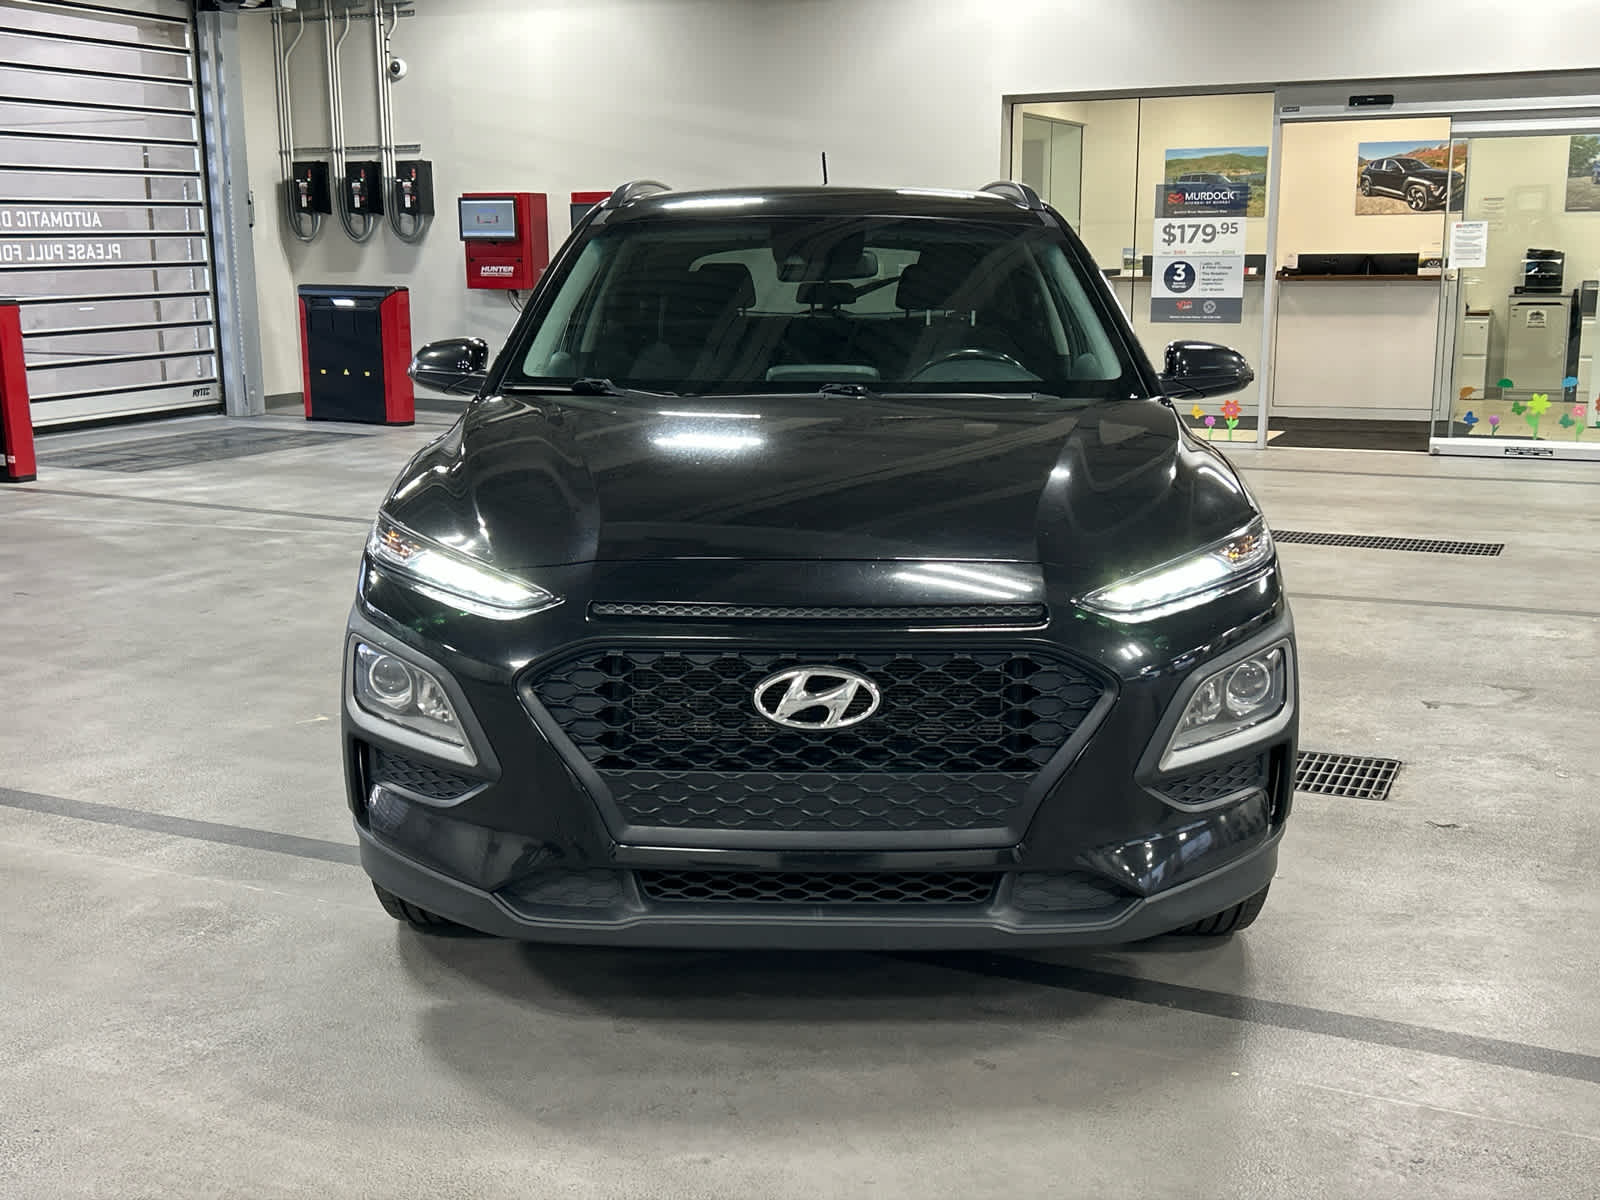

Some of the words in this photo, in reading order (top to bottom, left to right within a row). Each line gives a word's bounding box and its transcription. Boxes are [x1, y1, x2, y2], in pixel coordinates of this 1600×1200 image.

[1185, 191, 1234, 201] MURDOCK
[1162, 222, 1239, 246] $179.95
[480, 265, 514, 273] HUNTER
[1173, 264, 1186, 281] 3
